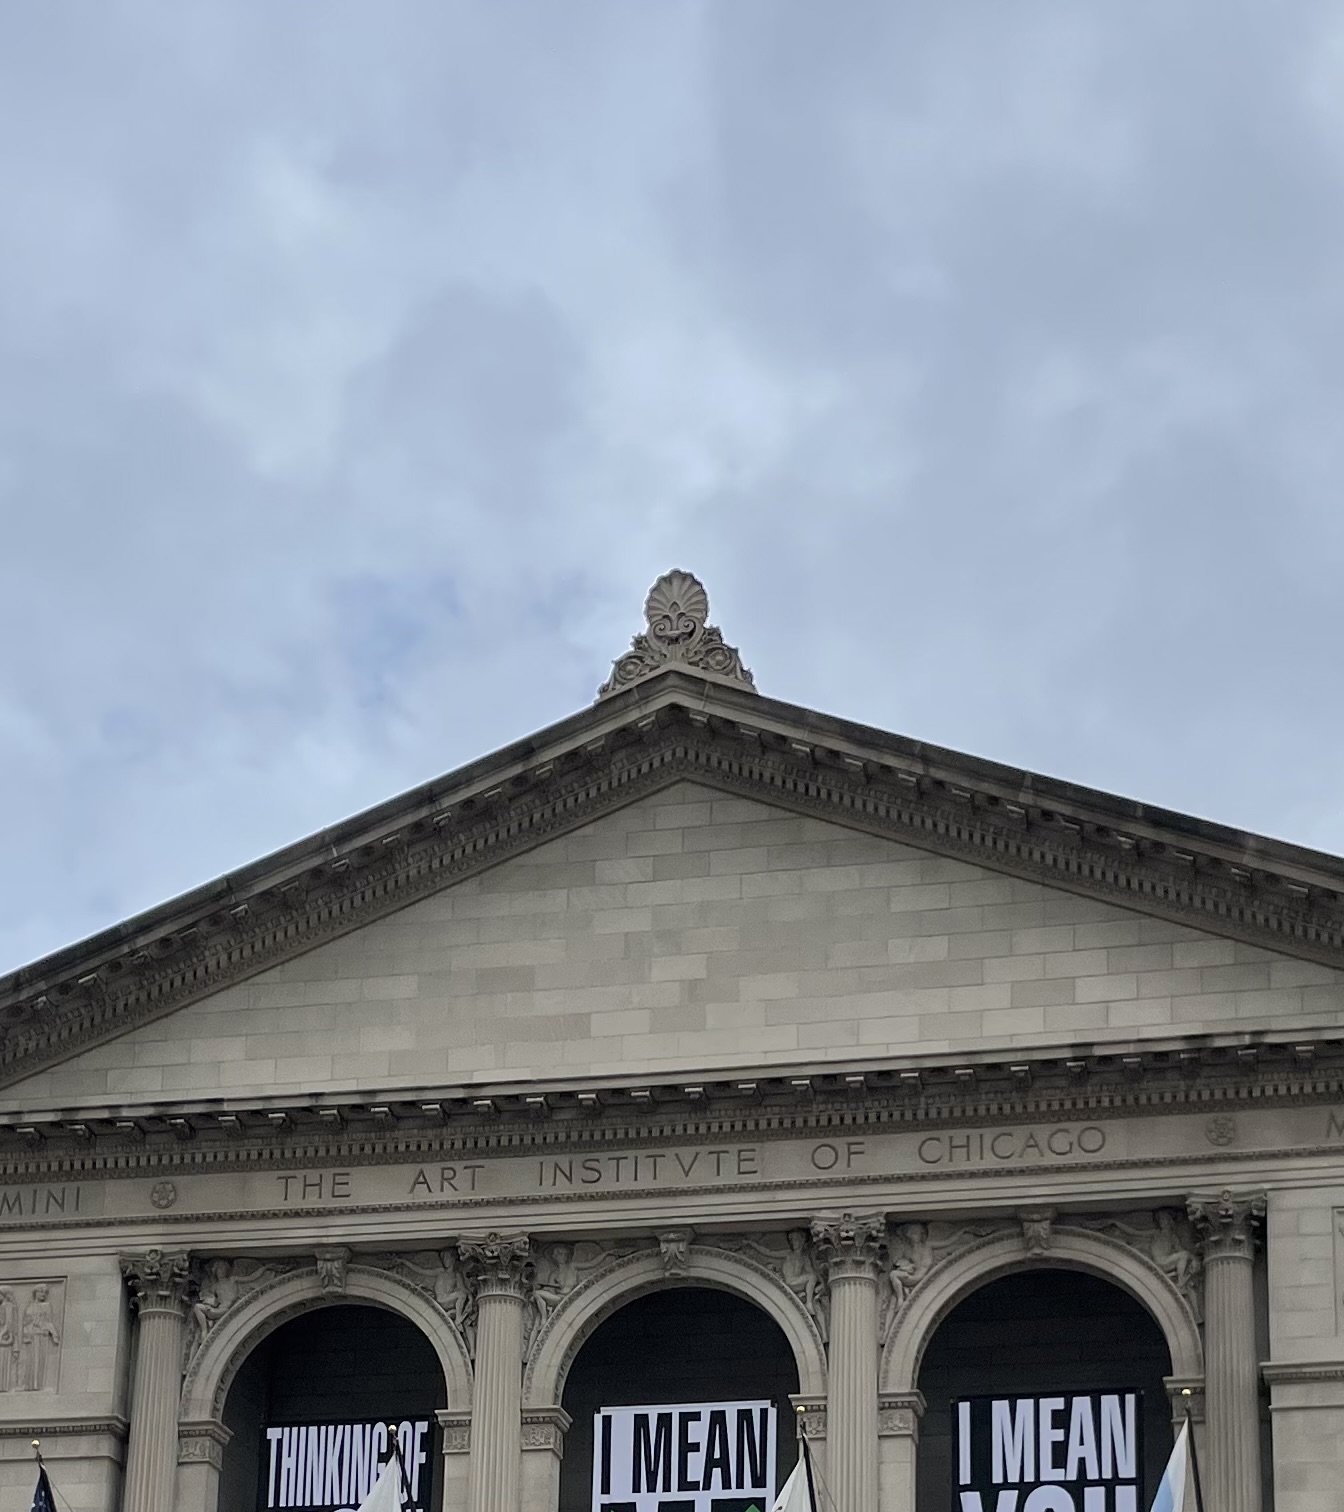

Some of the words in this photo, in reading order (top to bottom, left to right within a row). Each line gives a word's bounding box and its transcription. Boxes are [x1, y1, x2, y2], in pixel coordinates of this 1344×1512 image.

[276, 1172, 353, 1203] THE
[409, 1165, 486, 1195] ART
[539, 1148, 759, 1187] INSTITVTE
[811, 1142, 865, 1170] OF
[917, 1126, 1107, 1166] CHICAGO
[266, 1421, 389, 1508] THINKING
[397, 1421, 429, 1505] OF
[600, 1414, 613, 1495] I
[631, 1407, 769, 1494] MEAN
[958, 1401, 971, 1486] I
[991, 1393, 1137, 1484] MEAN
